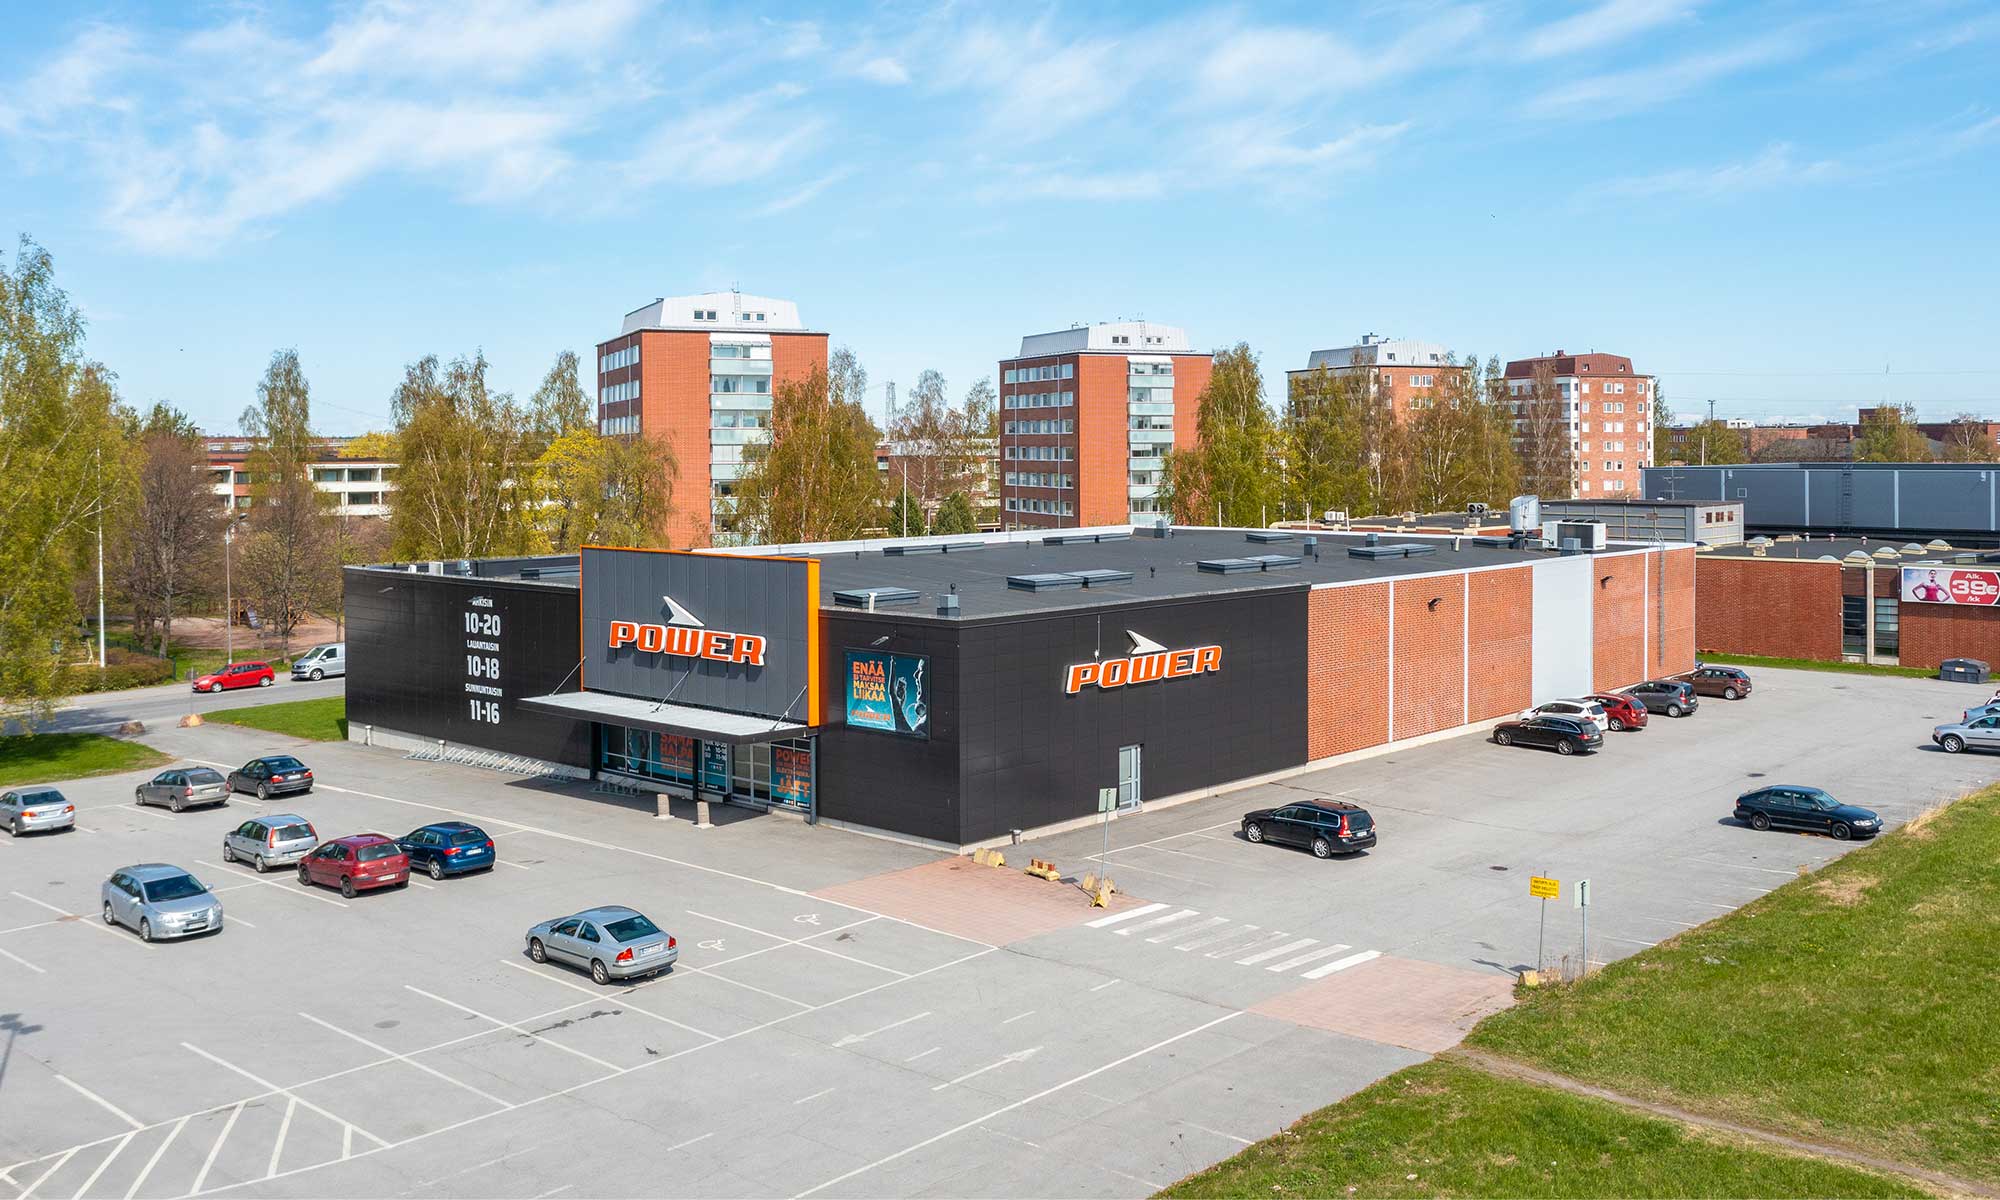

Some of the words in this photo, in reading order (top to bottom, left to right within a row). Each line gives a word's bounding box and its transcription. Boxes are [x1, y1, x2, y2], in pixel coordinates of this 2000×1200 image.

[464, 612, 501, 636] 10-20
[466, 639, 500, 652] LAUANTAISIN
[608, 620, 767, 666] POWER
[466, 655, 500, 680] 10-18
[852, 660, 885, 676] ENÄÄ
[1065, 645, 1222, 694] POWER
[465, 683, 503, 697] SUNNUNTAISIN
[853, 680, 886, 692] MAKSAA
[853, 688, 886, 702] LIIKAA
[470, 699, 500, 725] 11-16
